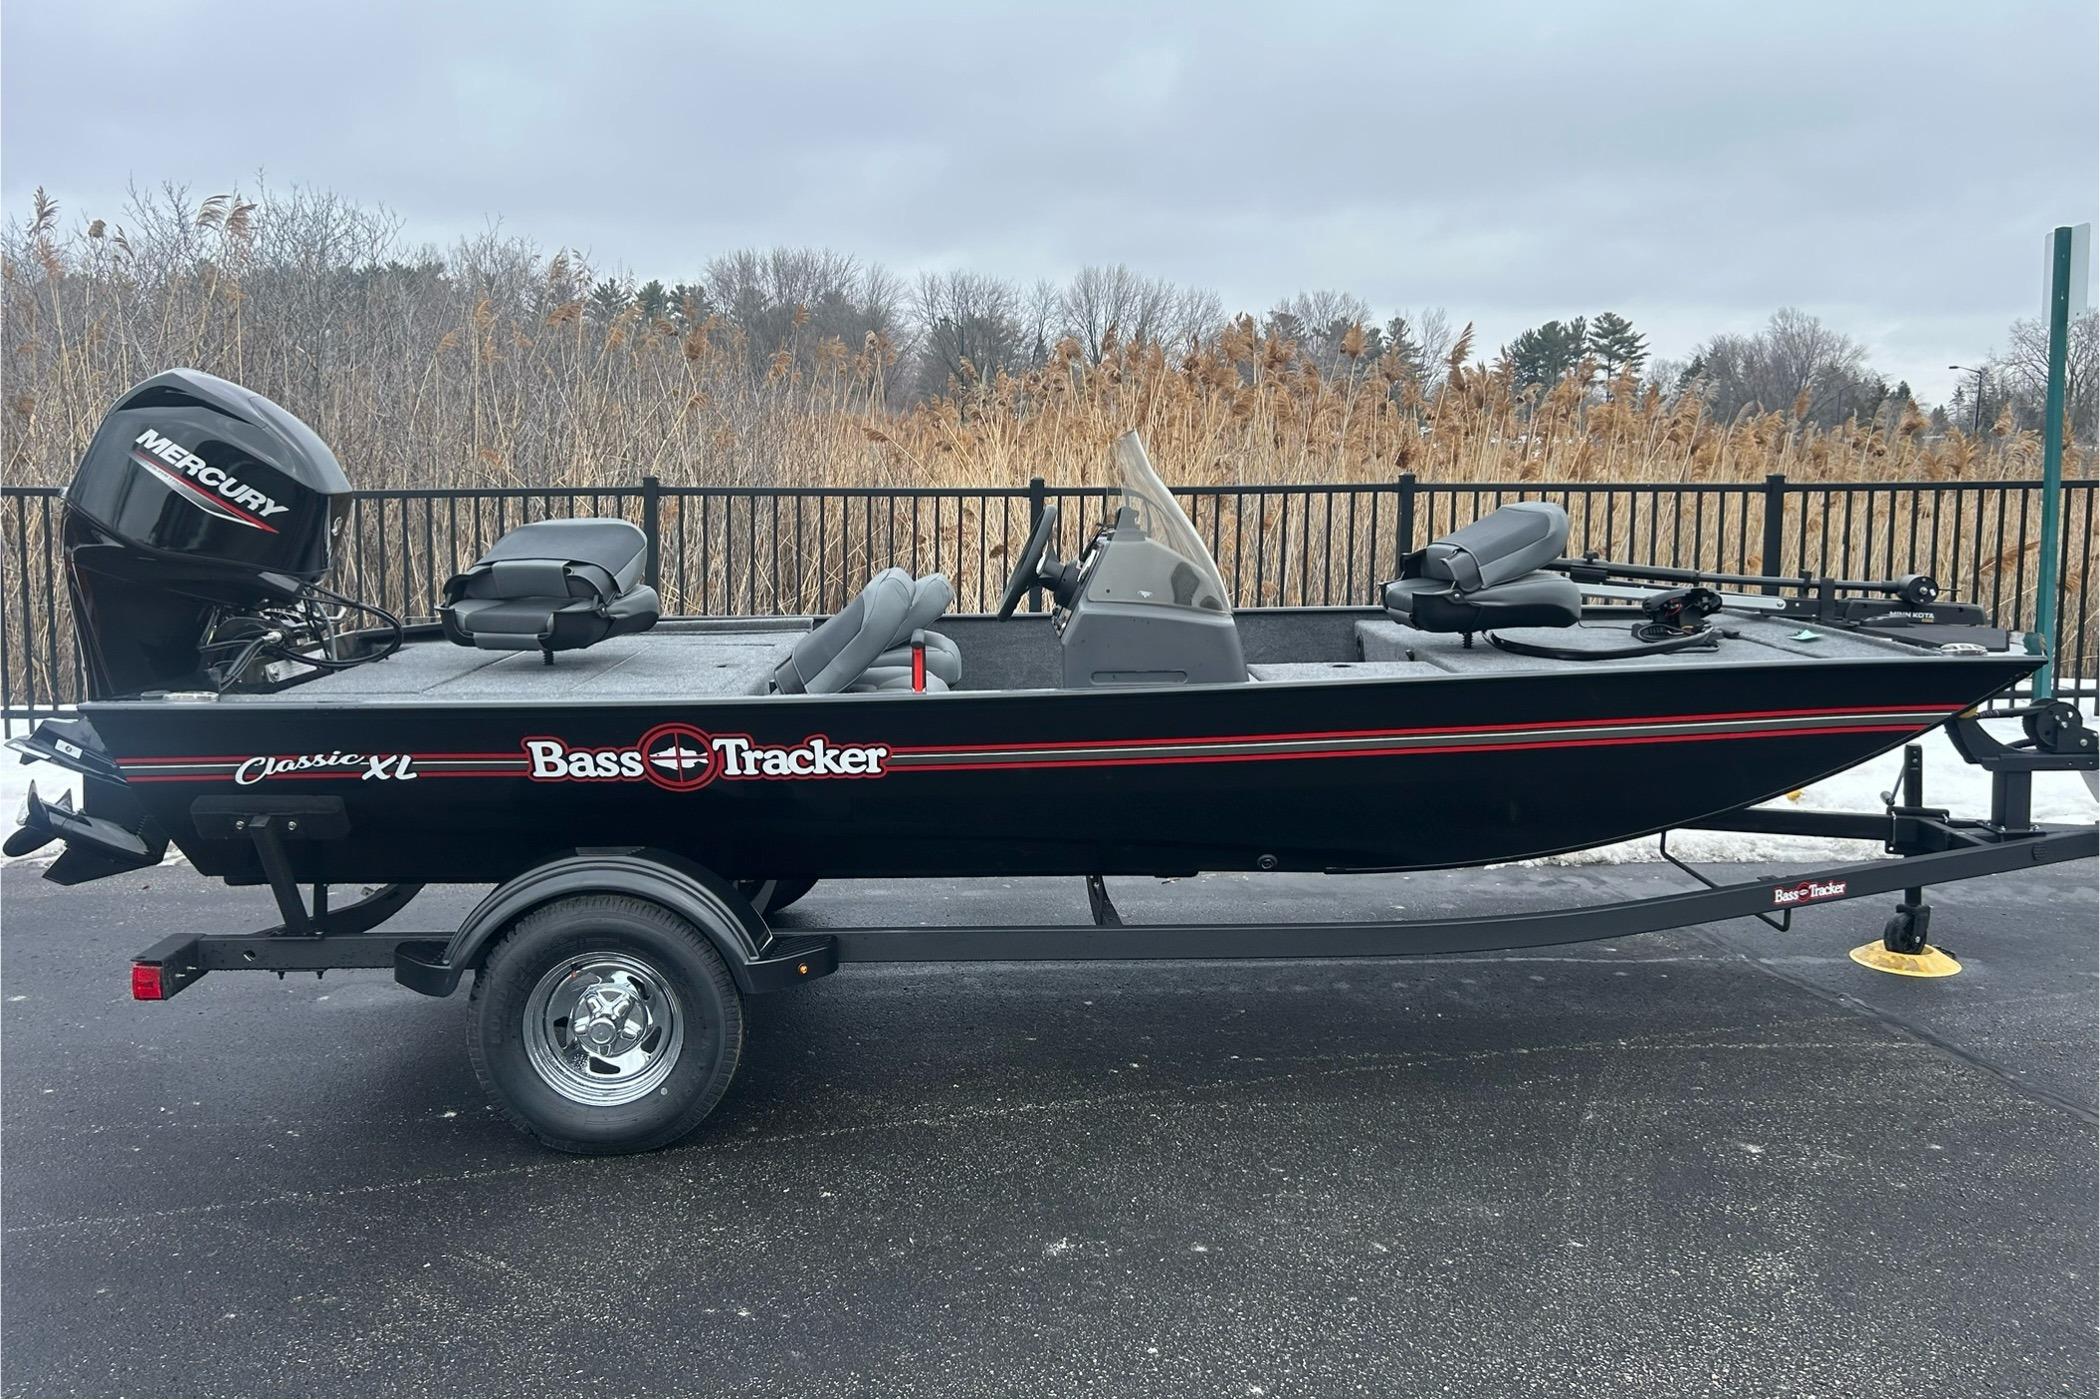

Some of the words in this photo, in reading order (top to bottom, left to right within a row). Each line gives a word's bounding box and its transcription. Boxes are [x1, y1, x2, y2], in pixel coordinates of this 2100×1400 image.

[135, 428, 290, 517] MERCURY
[1912, 611, 1935, 619] KOTA
[234, 750, 365, 786] Classic
[361, 754, 418, 781] XL
[526, 740, 645, 778] Bass
[712, 738, 887, 776] Tracker
[1774, 888, 1799, 903] Bass
[1808, 881, 1846, 898] Tracker
